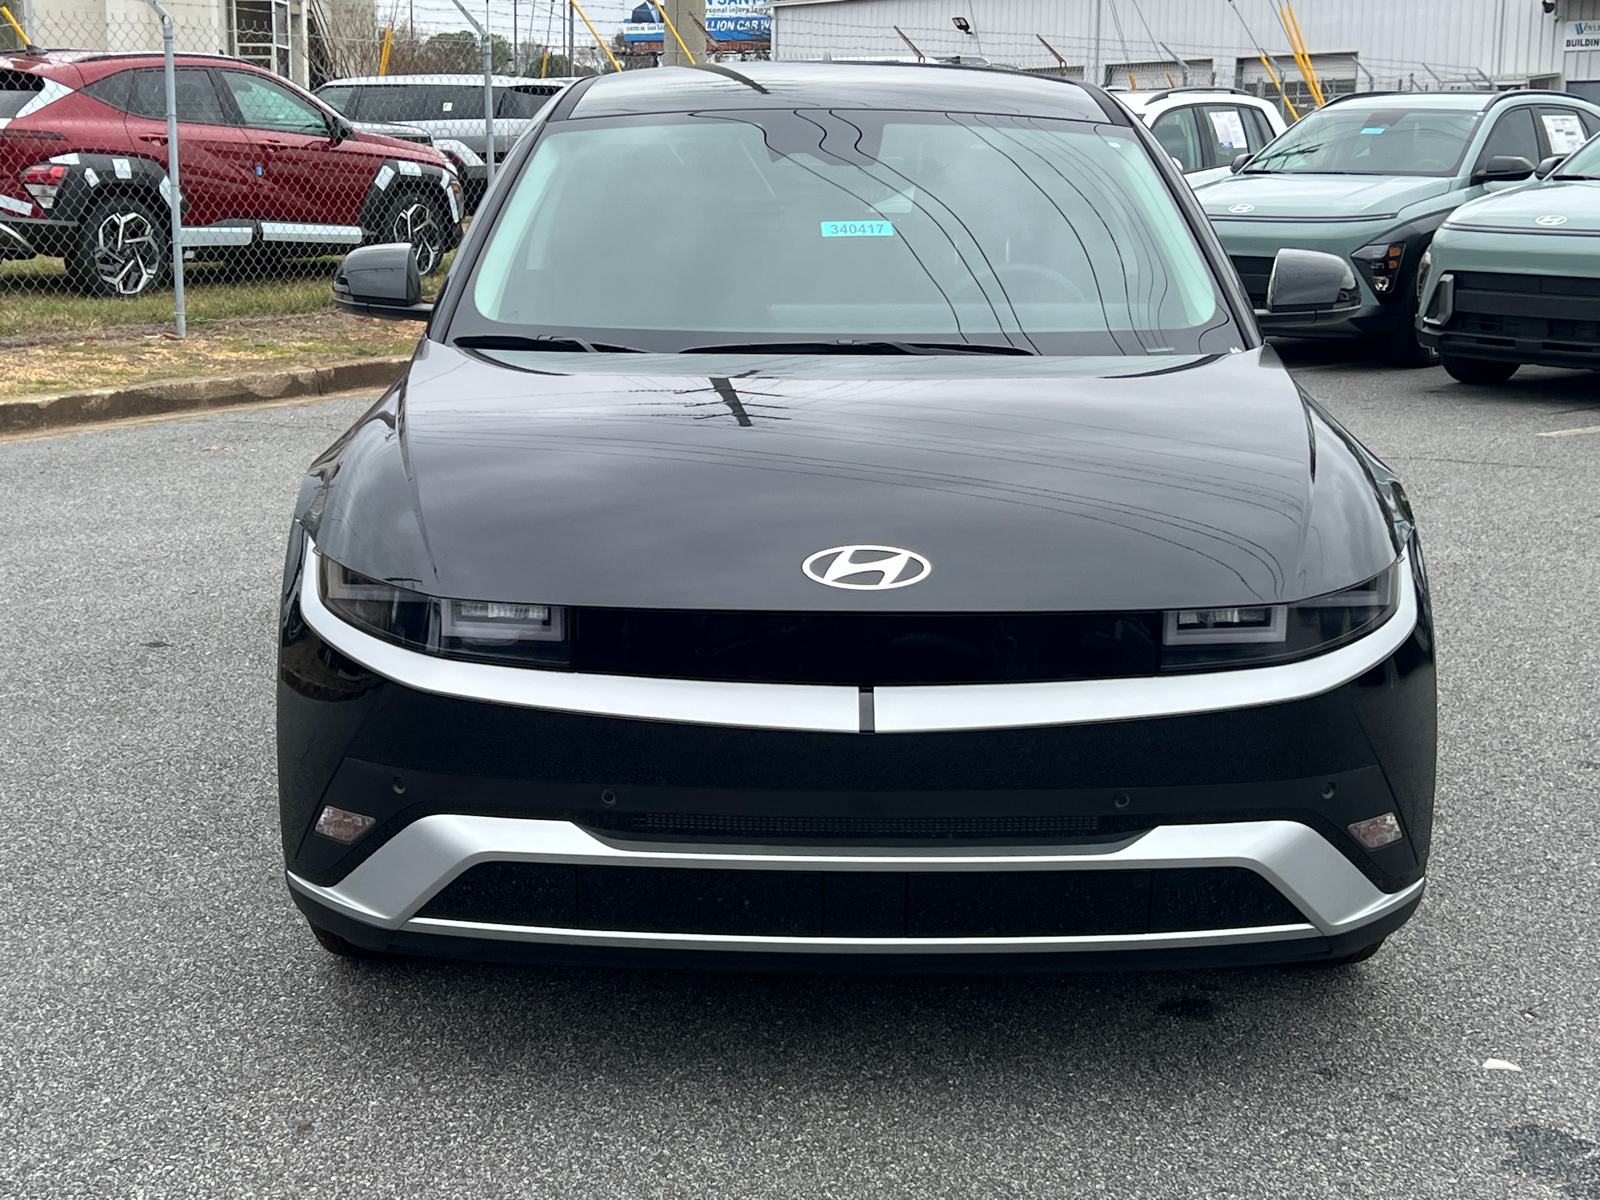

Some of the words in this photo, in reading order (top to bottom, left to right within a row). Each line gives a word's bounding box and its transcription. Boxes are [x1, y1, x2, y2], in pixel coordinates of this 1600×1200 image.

[737, 20, 758, 31] CAR
[1566, 38, 1600, 48] BUILDIN
[830, 223, 884, 235] 340417
